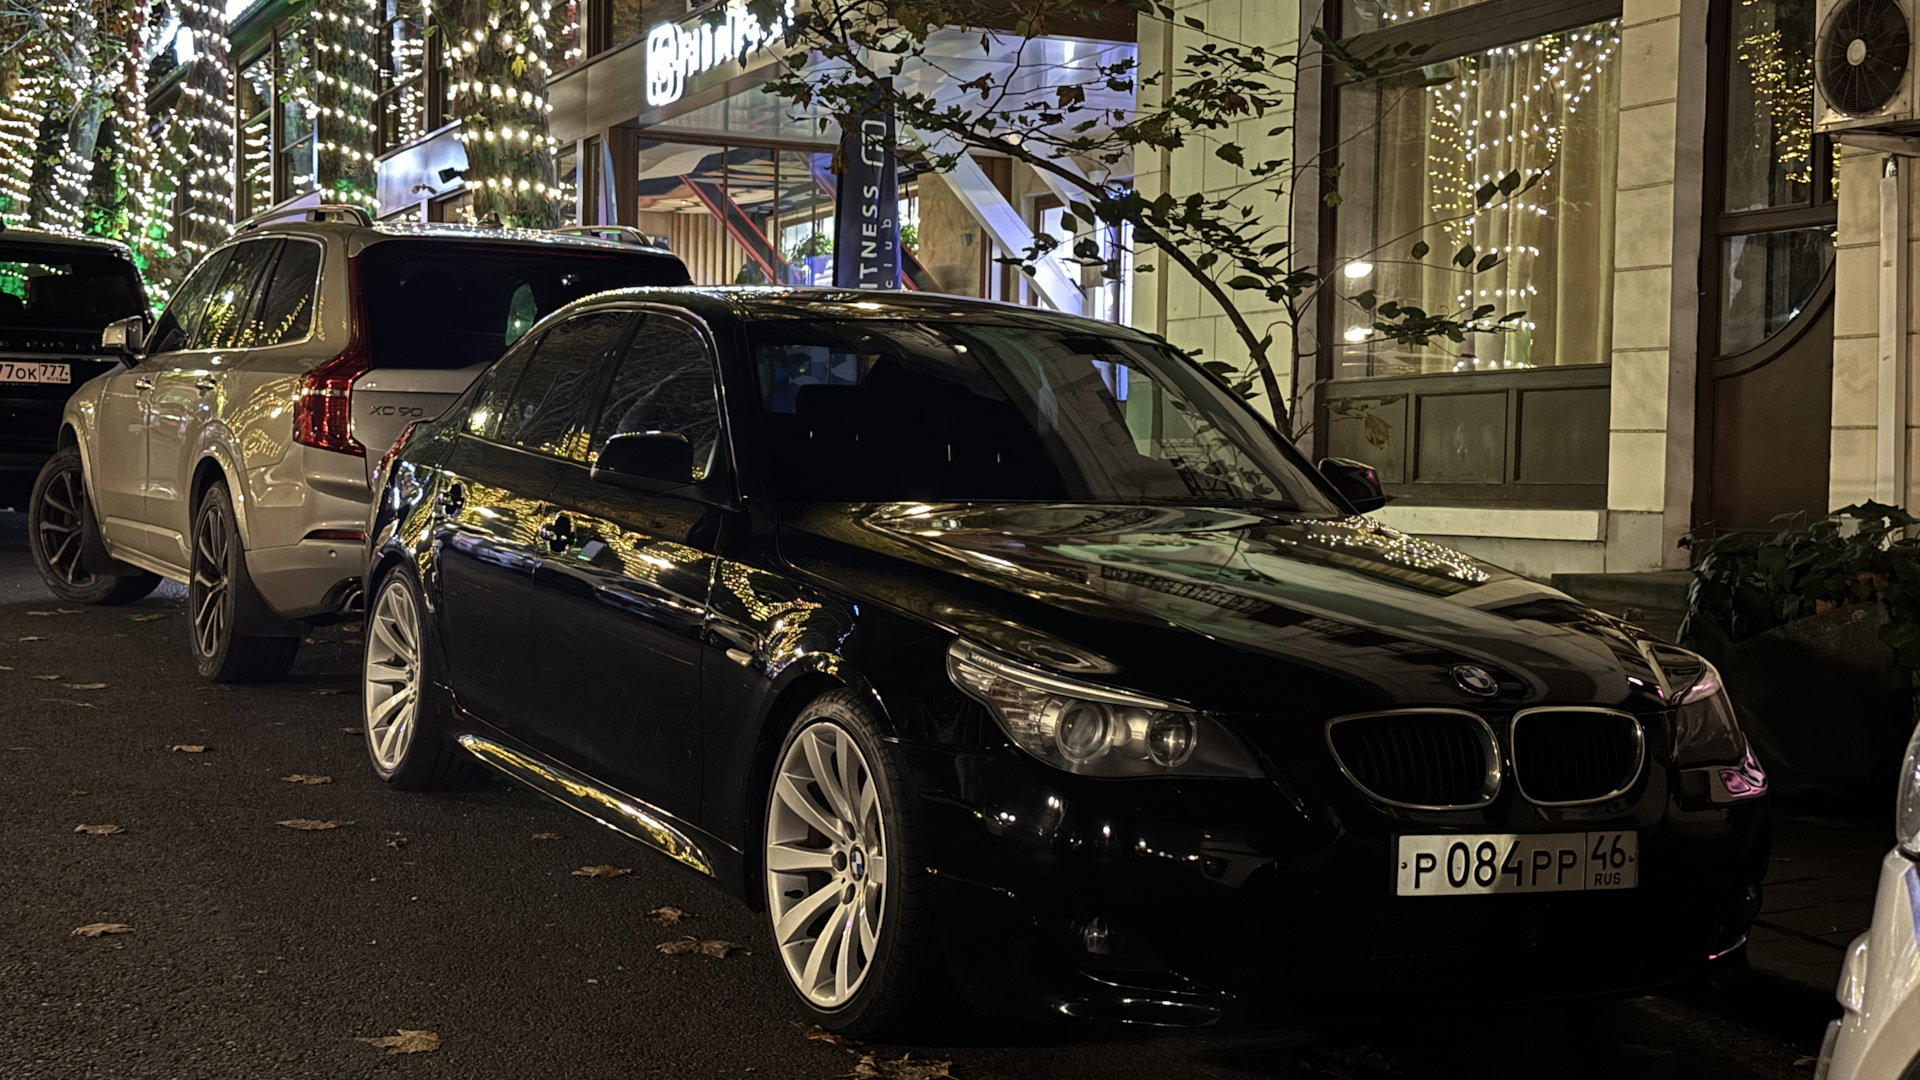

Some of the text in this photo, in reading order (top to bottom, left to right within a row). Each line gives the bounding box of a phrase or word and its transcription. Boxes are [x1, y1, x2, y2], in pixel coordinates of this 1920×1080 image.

[859, 185, 879, 289] ITNESS
[881, 219, 893, 288] club
[41, 364, 66, 377] 777
[1414, 834, 1626, 889] P084PP 46
[1593, 872, 1622, 887] RUS
